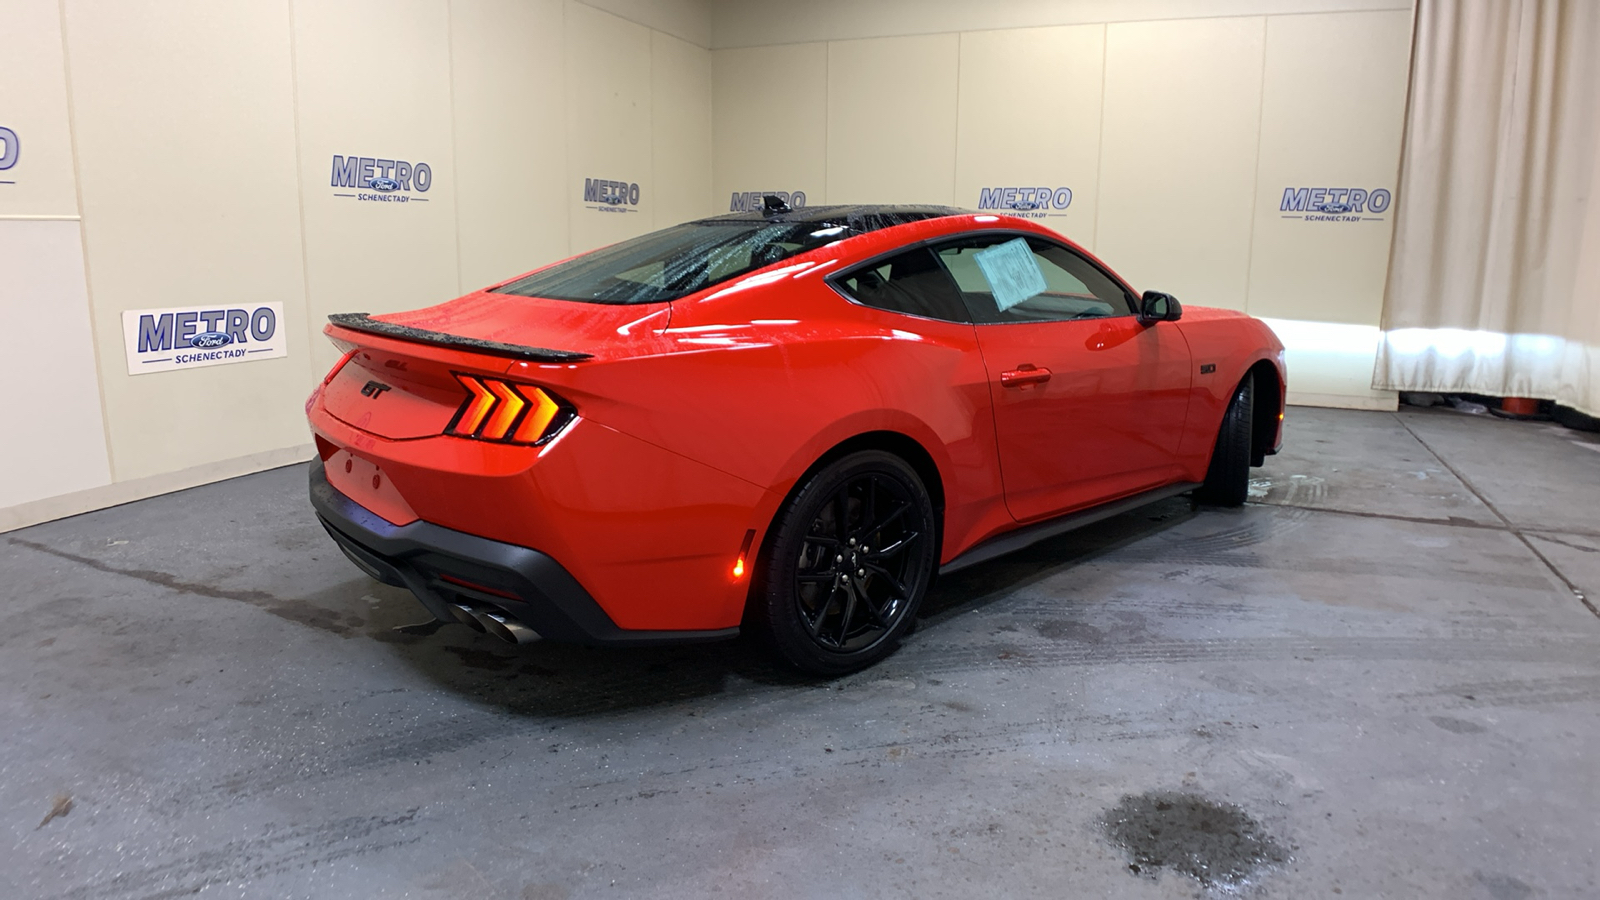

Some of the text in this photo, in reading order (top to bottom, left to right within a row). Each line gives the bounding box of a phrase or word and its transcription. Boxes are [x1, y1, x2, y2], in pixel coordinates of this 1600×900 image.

[331, 155, 432, 192] METRO
[358, 193, 410, 203] SCHENECTADY
[584, 178, 640, 206] METRO
[978, 187, 1073, 210] METRO
[1280, 188, 1392, 213] METRO
[138, 307, 276, 353] METRO
[175, 348, 247, 364] SCHENECTADY
[361, 380, 392, 400] GT
